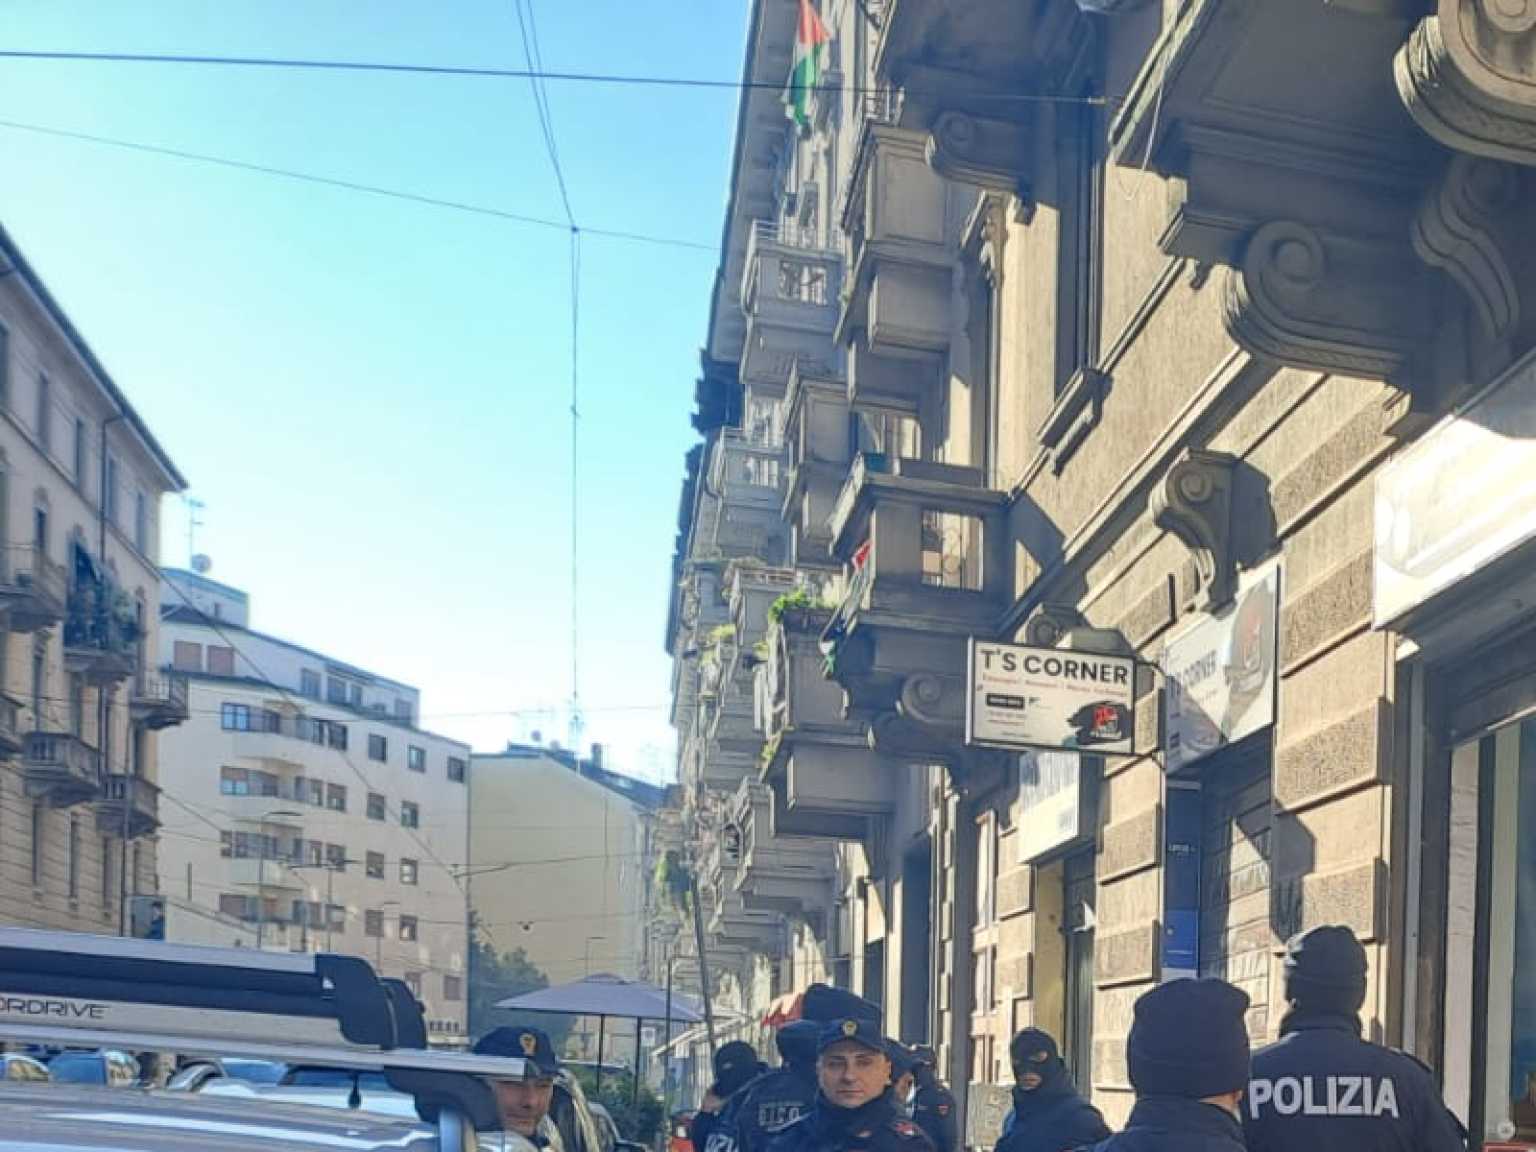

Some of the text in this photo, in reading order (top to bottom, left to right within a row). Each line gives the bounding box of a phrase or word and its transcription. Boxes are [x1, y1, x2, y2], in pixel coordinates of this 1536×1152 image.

[981, 648, 1128, 684] T'S CORNER
[1248, 1076, 1399, 1118] POLIZIA
